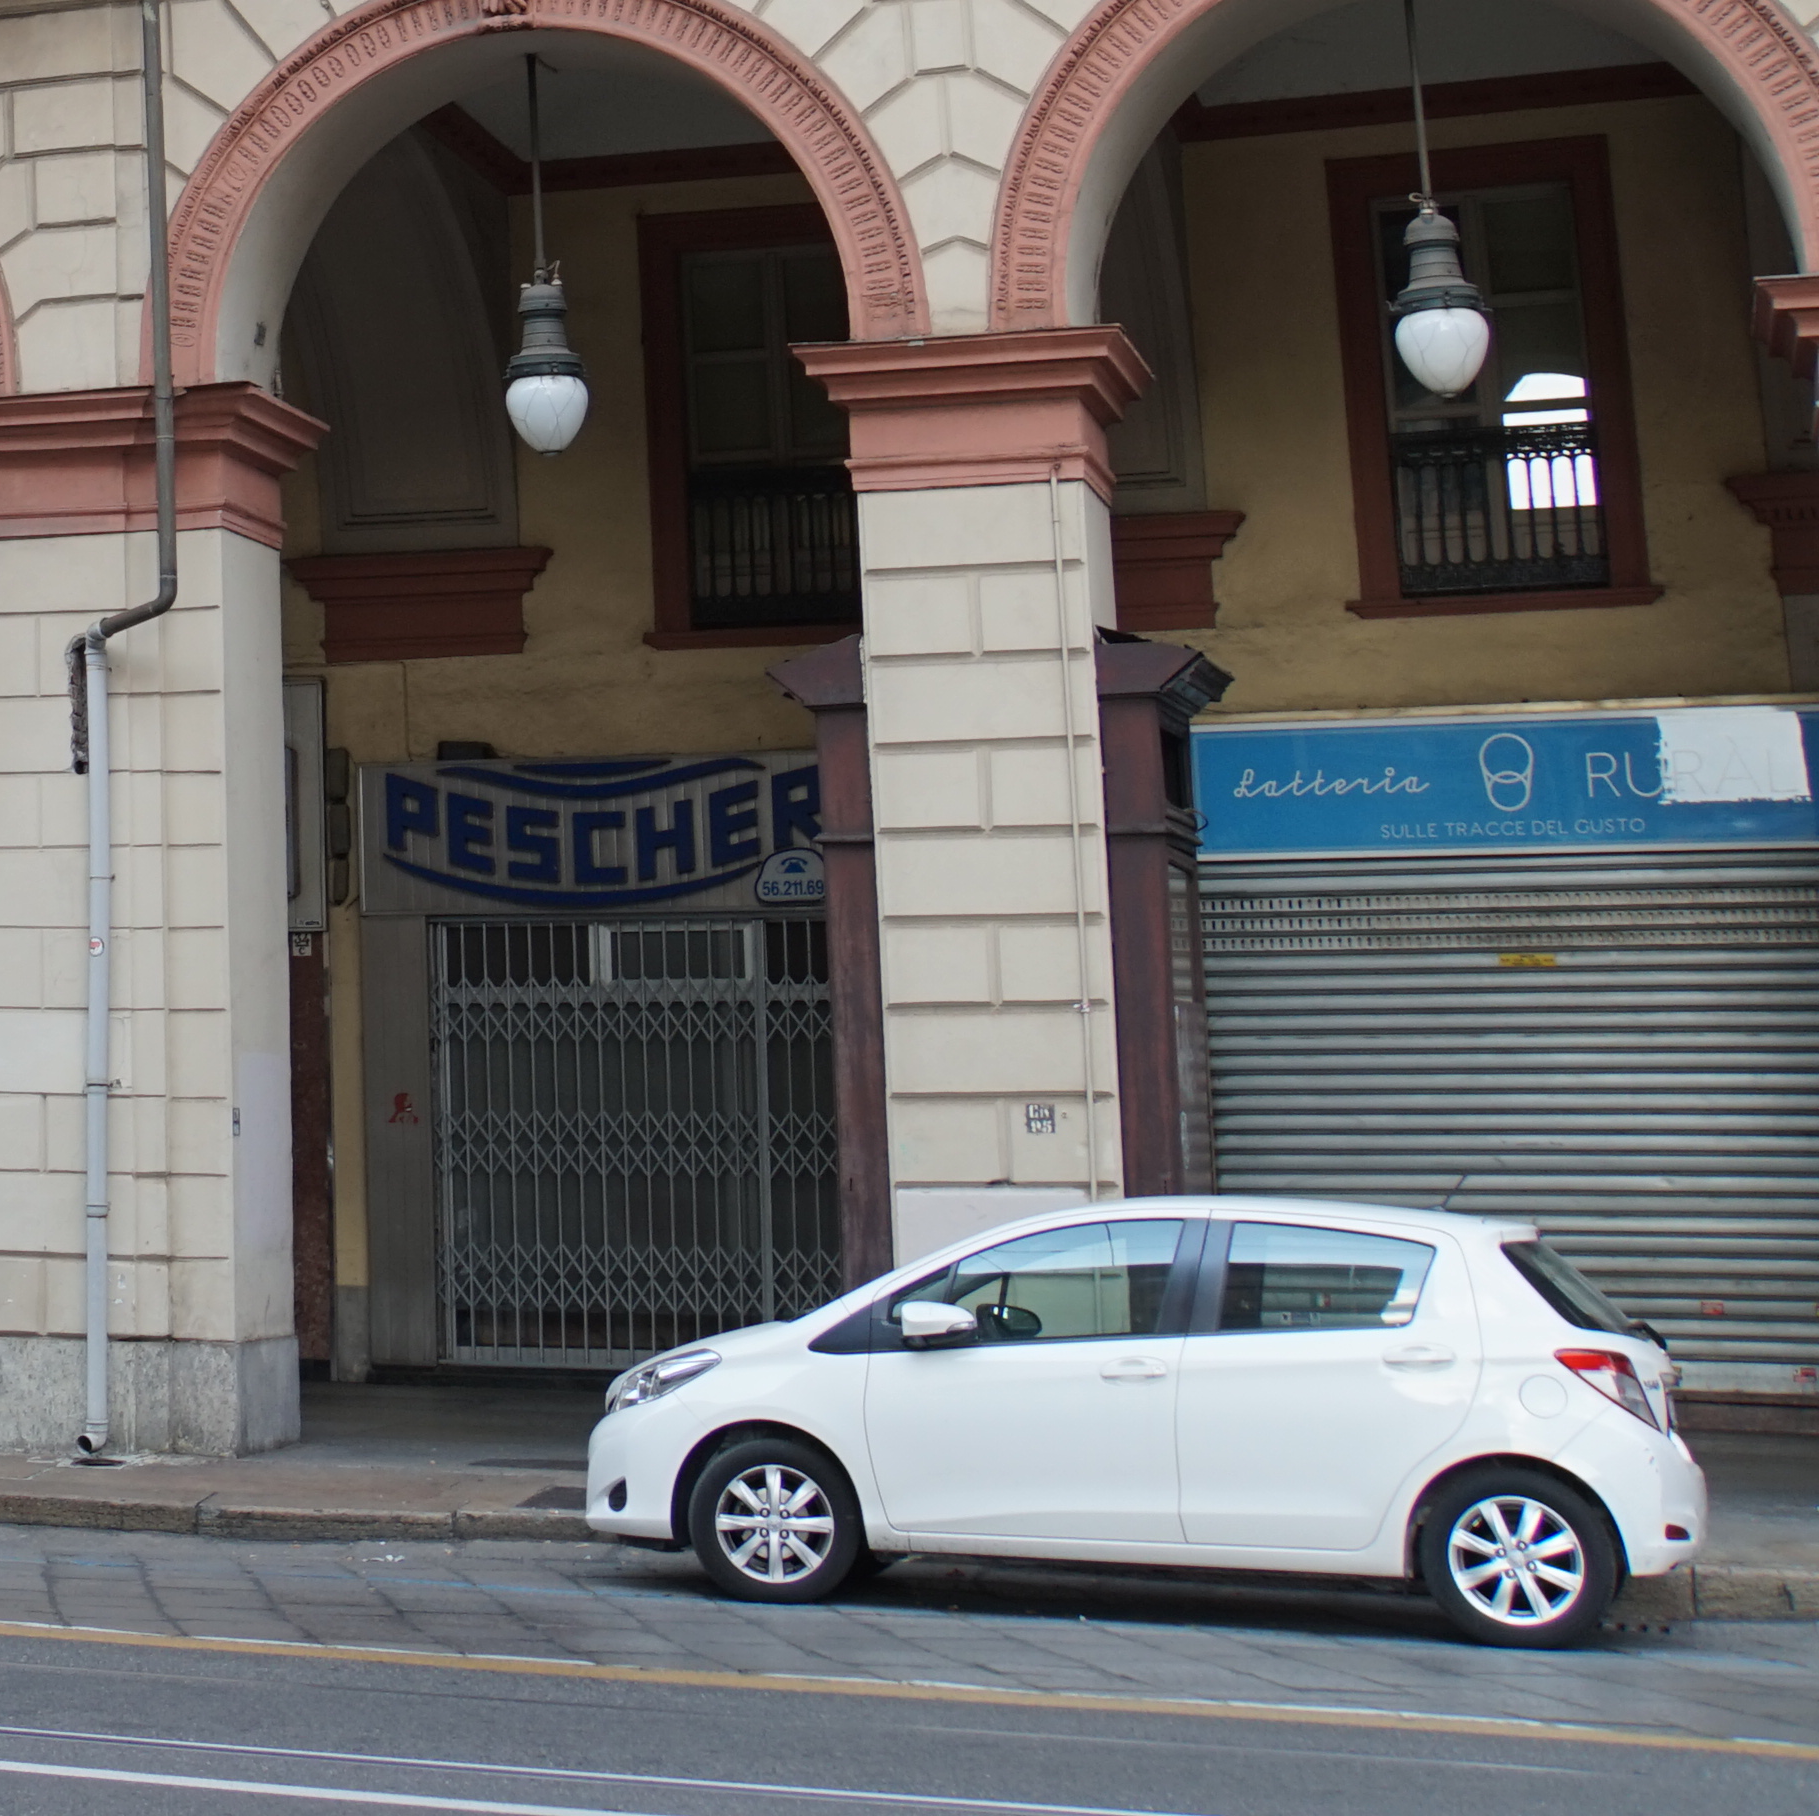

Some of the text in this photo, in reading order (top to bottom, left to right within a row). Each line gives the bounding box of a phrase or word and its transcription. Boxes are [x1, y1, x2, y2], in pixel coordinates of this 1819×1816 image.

[1233, 767, 1430, 799] Latteria
[385, 765, 821, 884] PESCHER
[1381, 818, 1646, 838] SULLE TRACCE DEL GUSTO
[762, 879, 824, 896] 56.211.69
